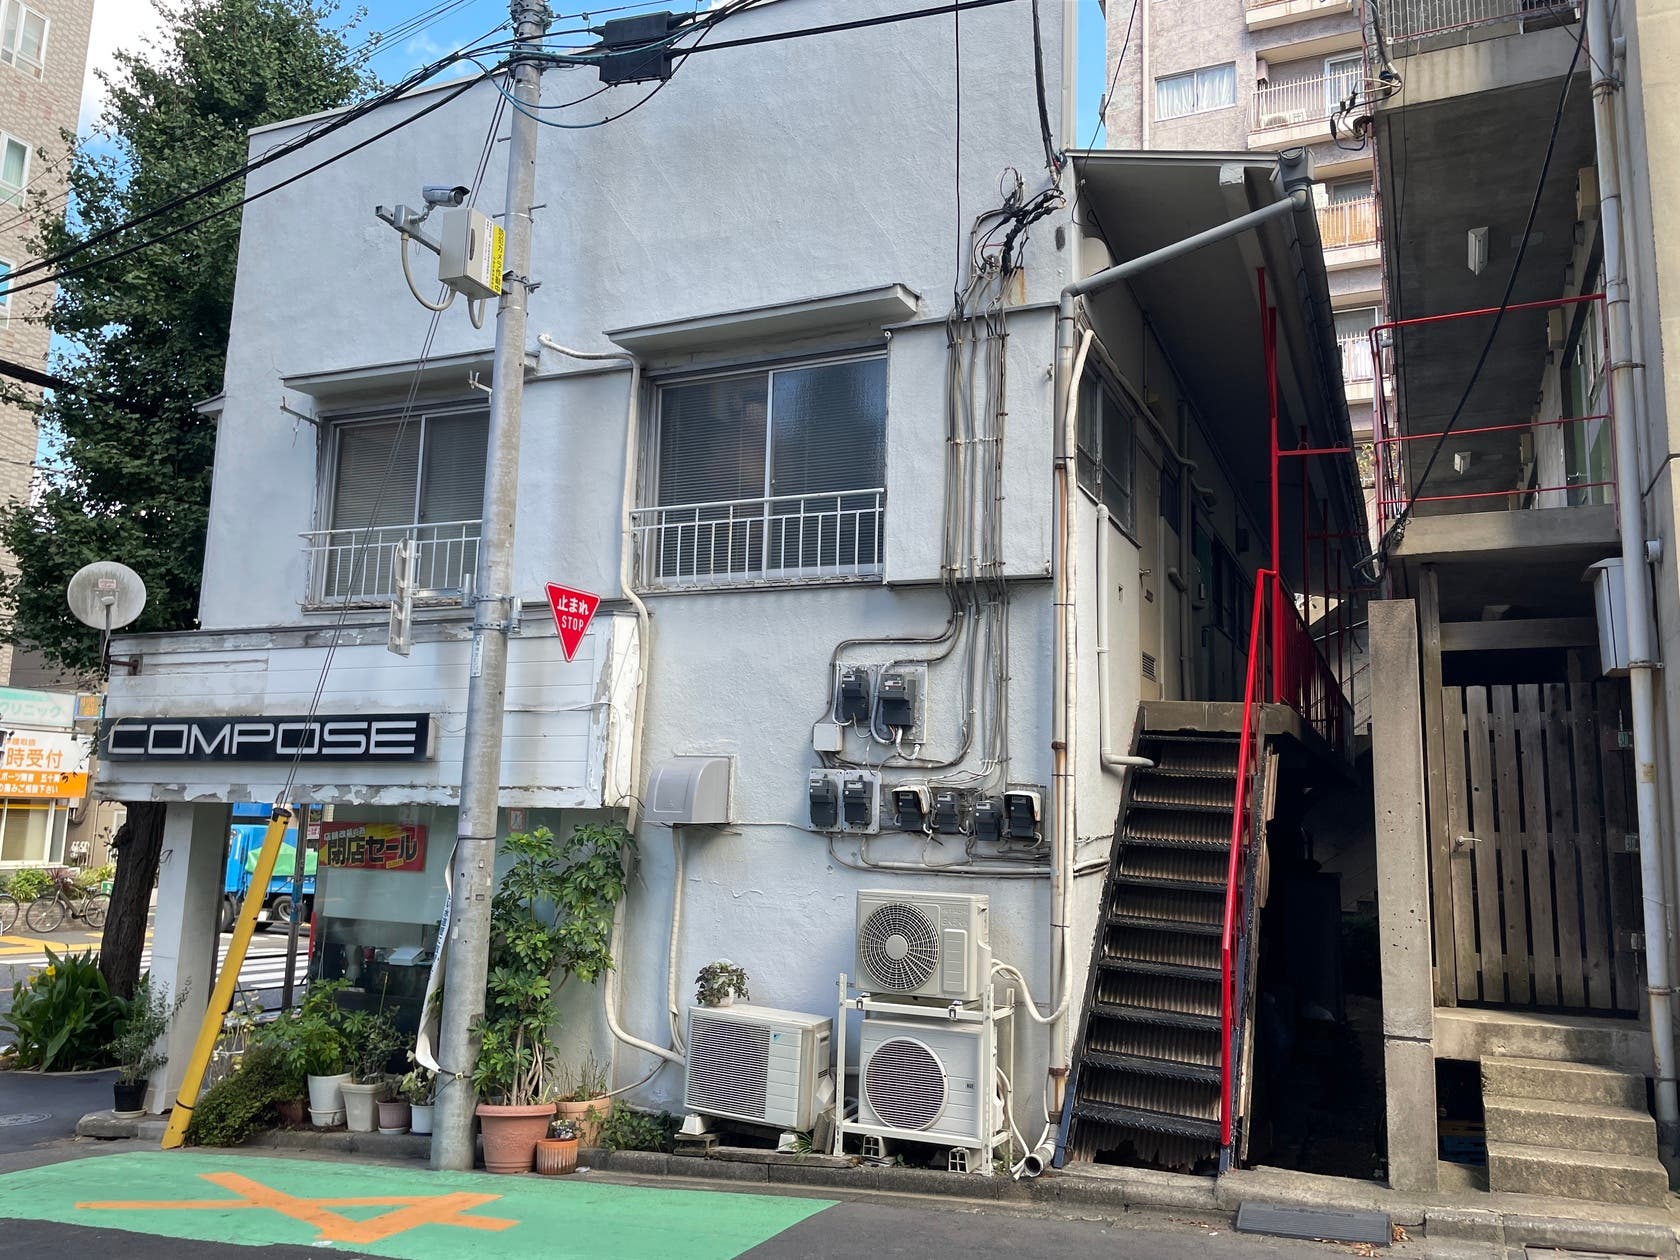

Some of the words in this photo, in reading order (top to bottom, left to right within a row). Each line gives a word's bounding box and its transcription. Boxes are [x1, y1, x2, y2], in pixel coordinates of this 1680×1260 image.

[557, 594, 589, 616] 止まれ
[561, 615, 584, 631] STOP
[107, 720, 417, 755] COMPOSE
[327, 833, 418, 866] 閉店セール
